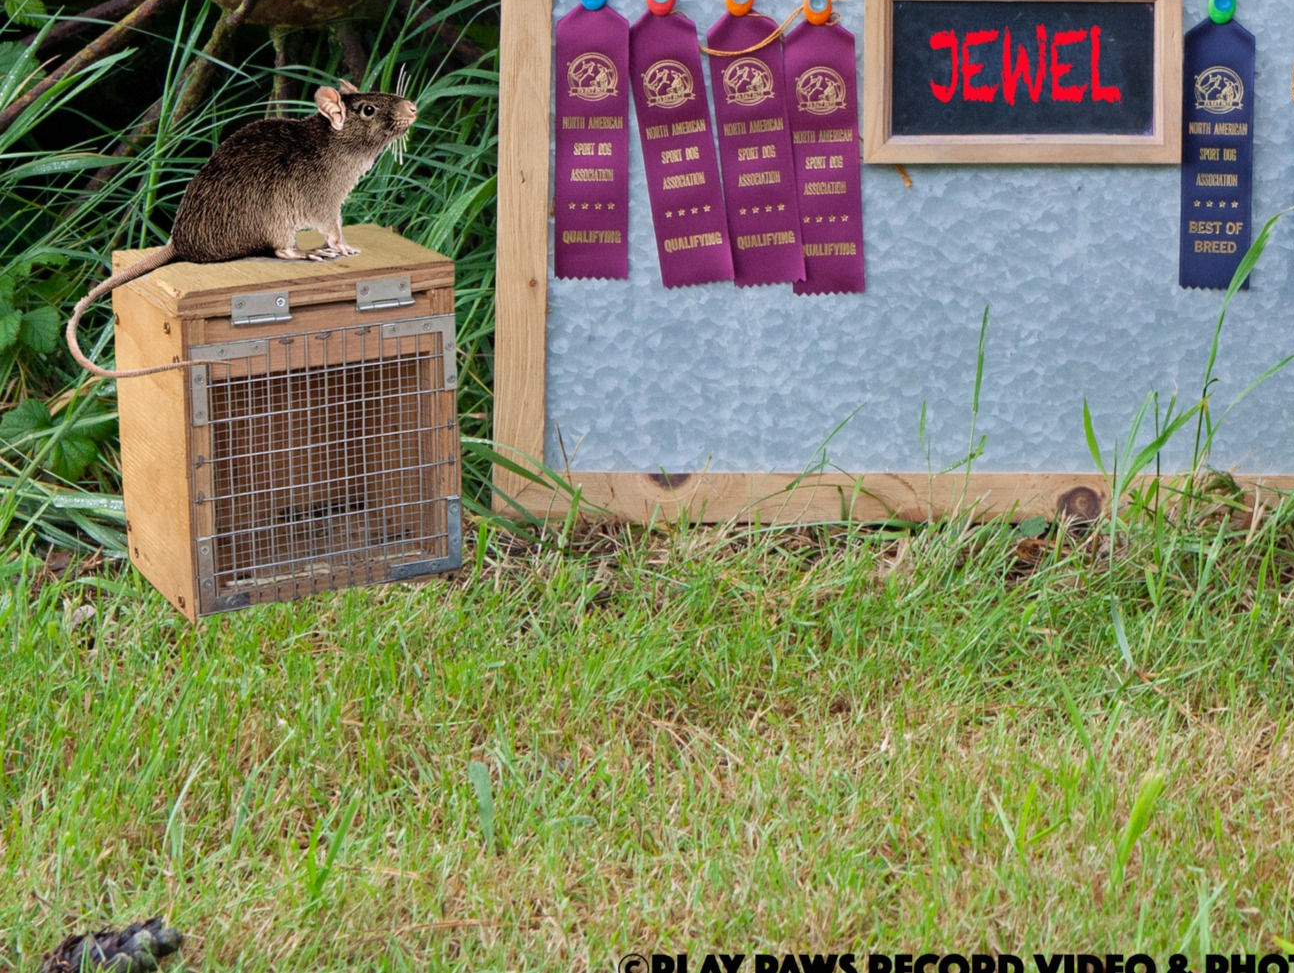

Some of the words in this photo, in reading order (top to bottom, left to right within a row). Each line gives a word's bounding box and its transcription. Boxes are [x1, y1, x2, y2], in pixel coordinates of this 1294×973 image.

[562, 116, 585, 129] NORTH
[588, 116, 623, 129] AMERICAN
[645, 124, 669, 140] NORTH
[671, 118, 706, 137] AMERICAN
[749, 117, 784, 134] AMERICAN
[1189, 121, 1211, 135] NORTH
[1213, 122, 1248, 136] AMERICAN
[818, 128, 853, 143] AMERICAN
[573, 142, 595, 156] SPORT
[598, 142, 612, 156] DOG
[661, 149, 682, 164] SPORT
[685, 146, 700, 161] DOG
[737, 146, 759, 161] SPORT
[762, 144, 776, 159] DOG
[1199, 148, 1220, 161] SPORT
[1223, 148, 1238, 162] DOG
[805, 156, 827, 169] SPORT
[829, 155, 844, 168] DOG
[570, 169, 614, 182] ASSOCIATION
[662, 171, 706, 190] ASSOCIATION
[738, 170, 781, 187] ASSOCIATION
[1195, 173, 1238, 187] ASSOCIATION
[803, 181, 847, 195] ASSOCIATION
[1189, 220, 1223, 235] BEST
[1225, 221, 1244, 235] OF
[562, 230, 622, 244] QUALIFYING
[664, 231, 723, 253] QUALIFYING
[736, 230, 796, 250] QUALIFYING
[1194, 240, 1238, 254] BREED
